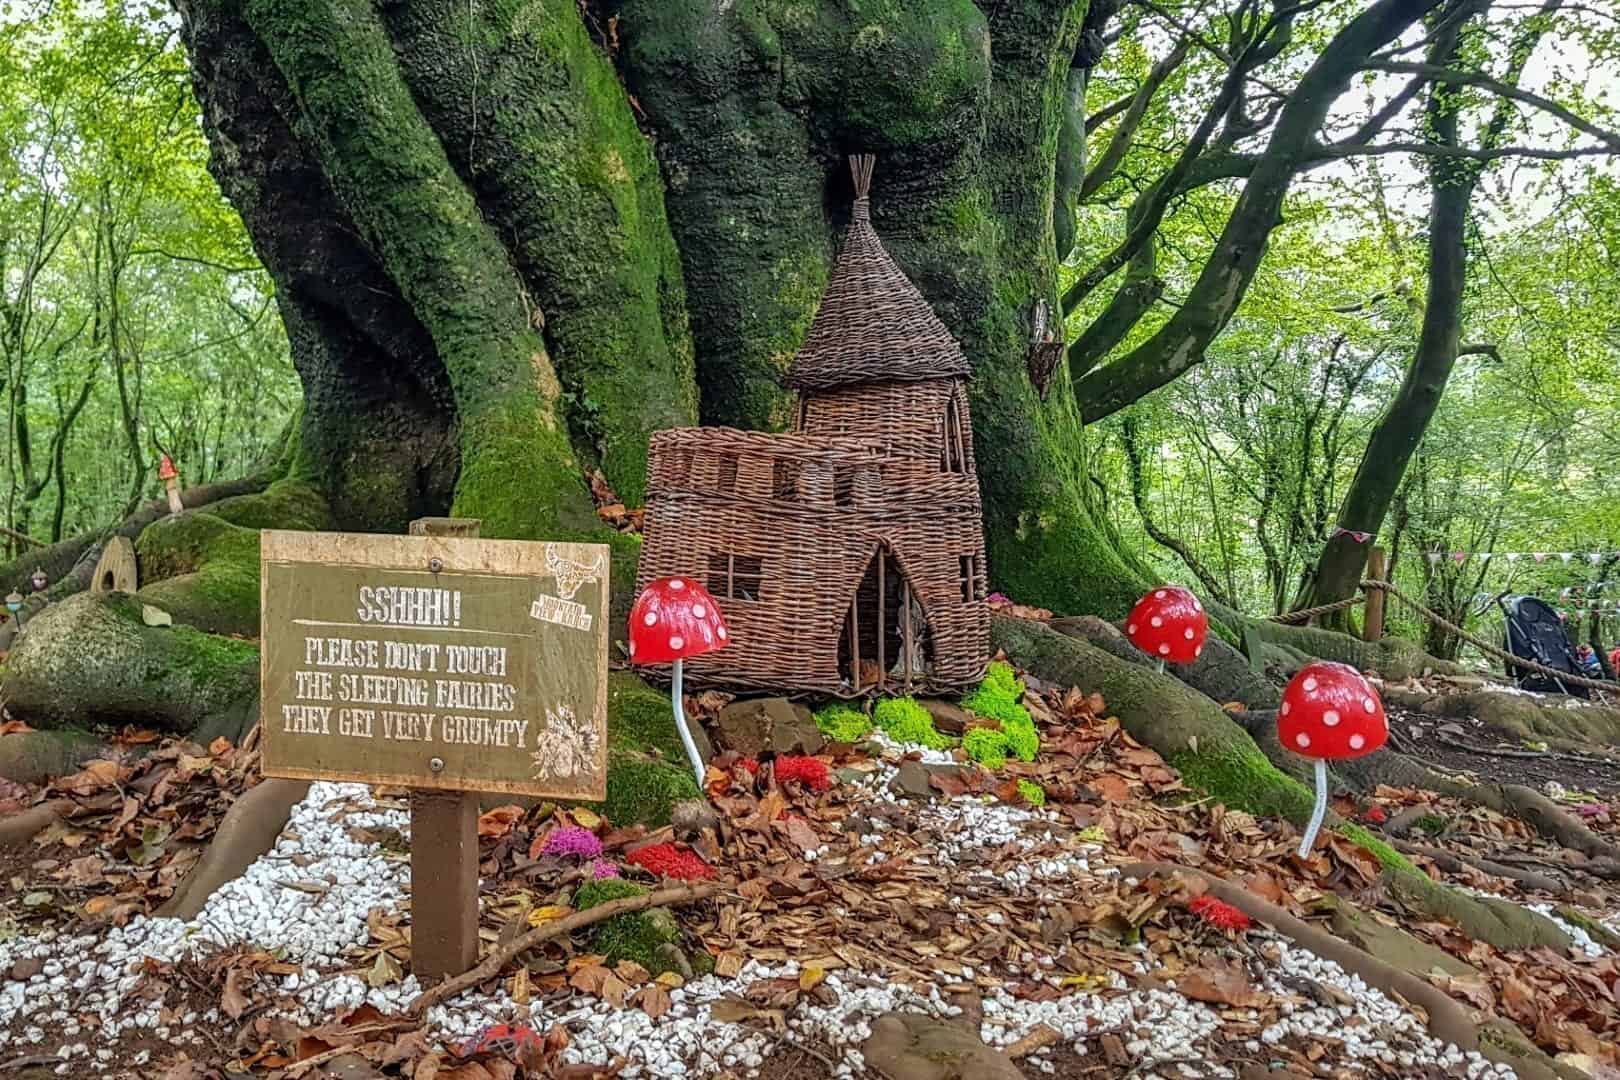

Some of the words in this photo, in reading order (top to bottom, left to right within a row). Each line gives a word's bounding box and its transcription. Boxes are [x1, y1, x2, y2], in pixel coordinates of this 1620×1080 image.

[357, 586, 461, 627] SSHHH!!
[305, 637, 378, 668] PLEASE
[384, 641, 440, 671] DON'T
[446, 645, 506, 676] TOUCH
[295, 671, 333, 700] THE
[338, 673, 428, 706] SLEEPING
[435, 679, 516, 712] FAIRIES
[282, 704, 332, 735] THEY
[338, 708, 375, 738] GET
[381, 711, 436, 741] VERY
[442, 715, 529, 748] GRUMPY
